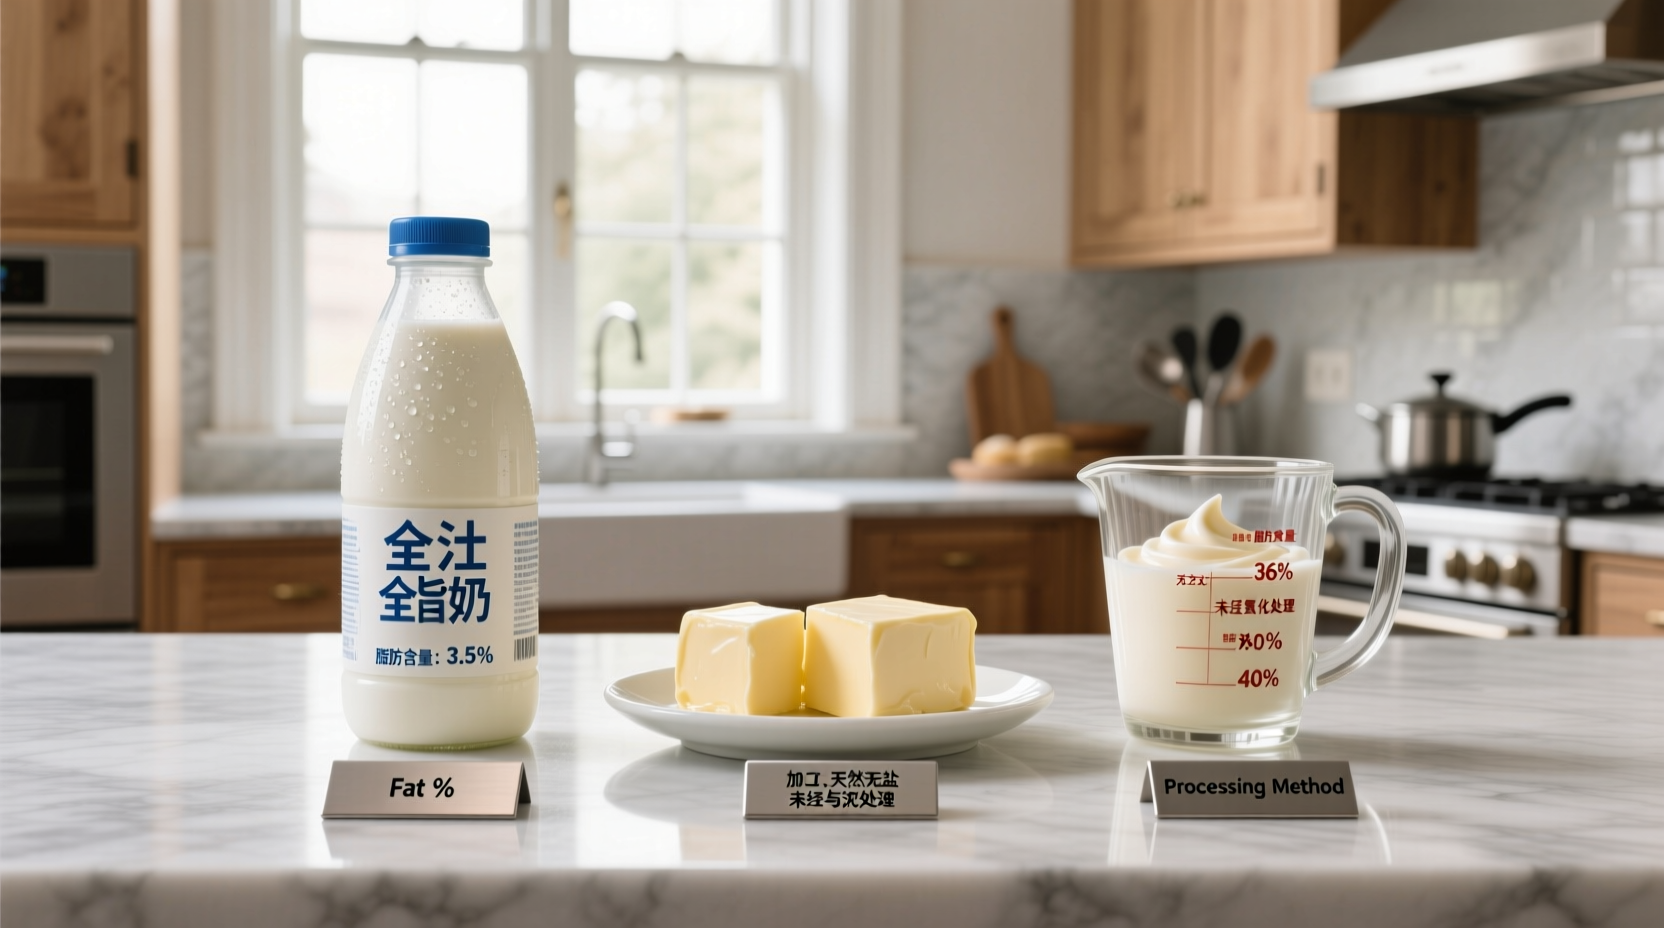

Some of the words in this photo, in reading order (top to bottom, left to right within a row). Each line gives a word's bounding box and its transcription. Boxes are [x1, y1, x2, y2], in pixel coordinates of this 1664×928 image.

[1254, 562, 1293, 581] 36%
[446, 645, 494, 665] 3.5%
[1238, 668, 1279, 688] 40%
[389, 777, 425, 798] Fat
[432, 777, 455, 798] %
[1164, 777, 1265, 800] Processing
[1272, 777, 1345, 795] Method
